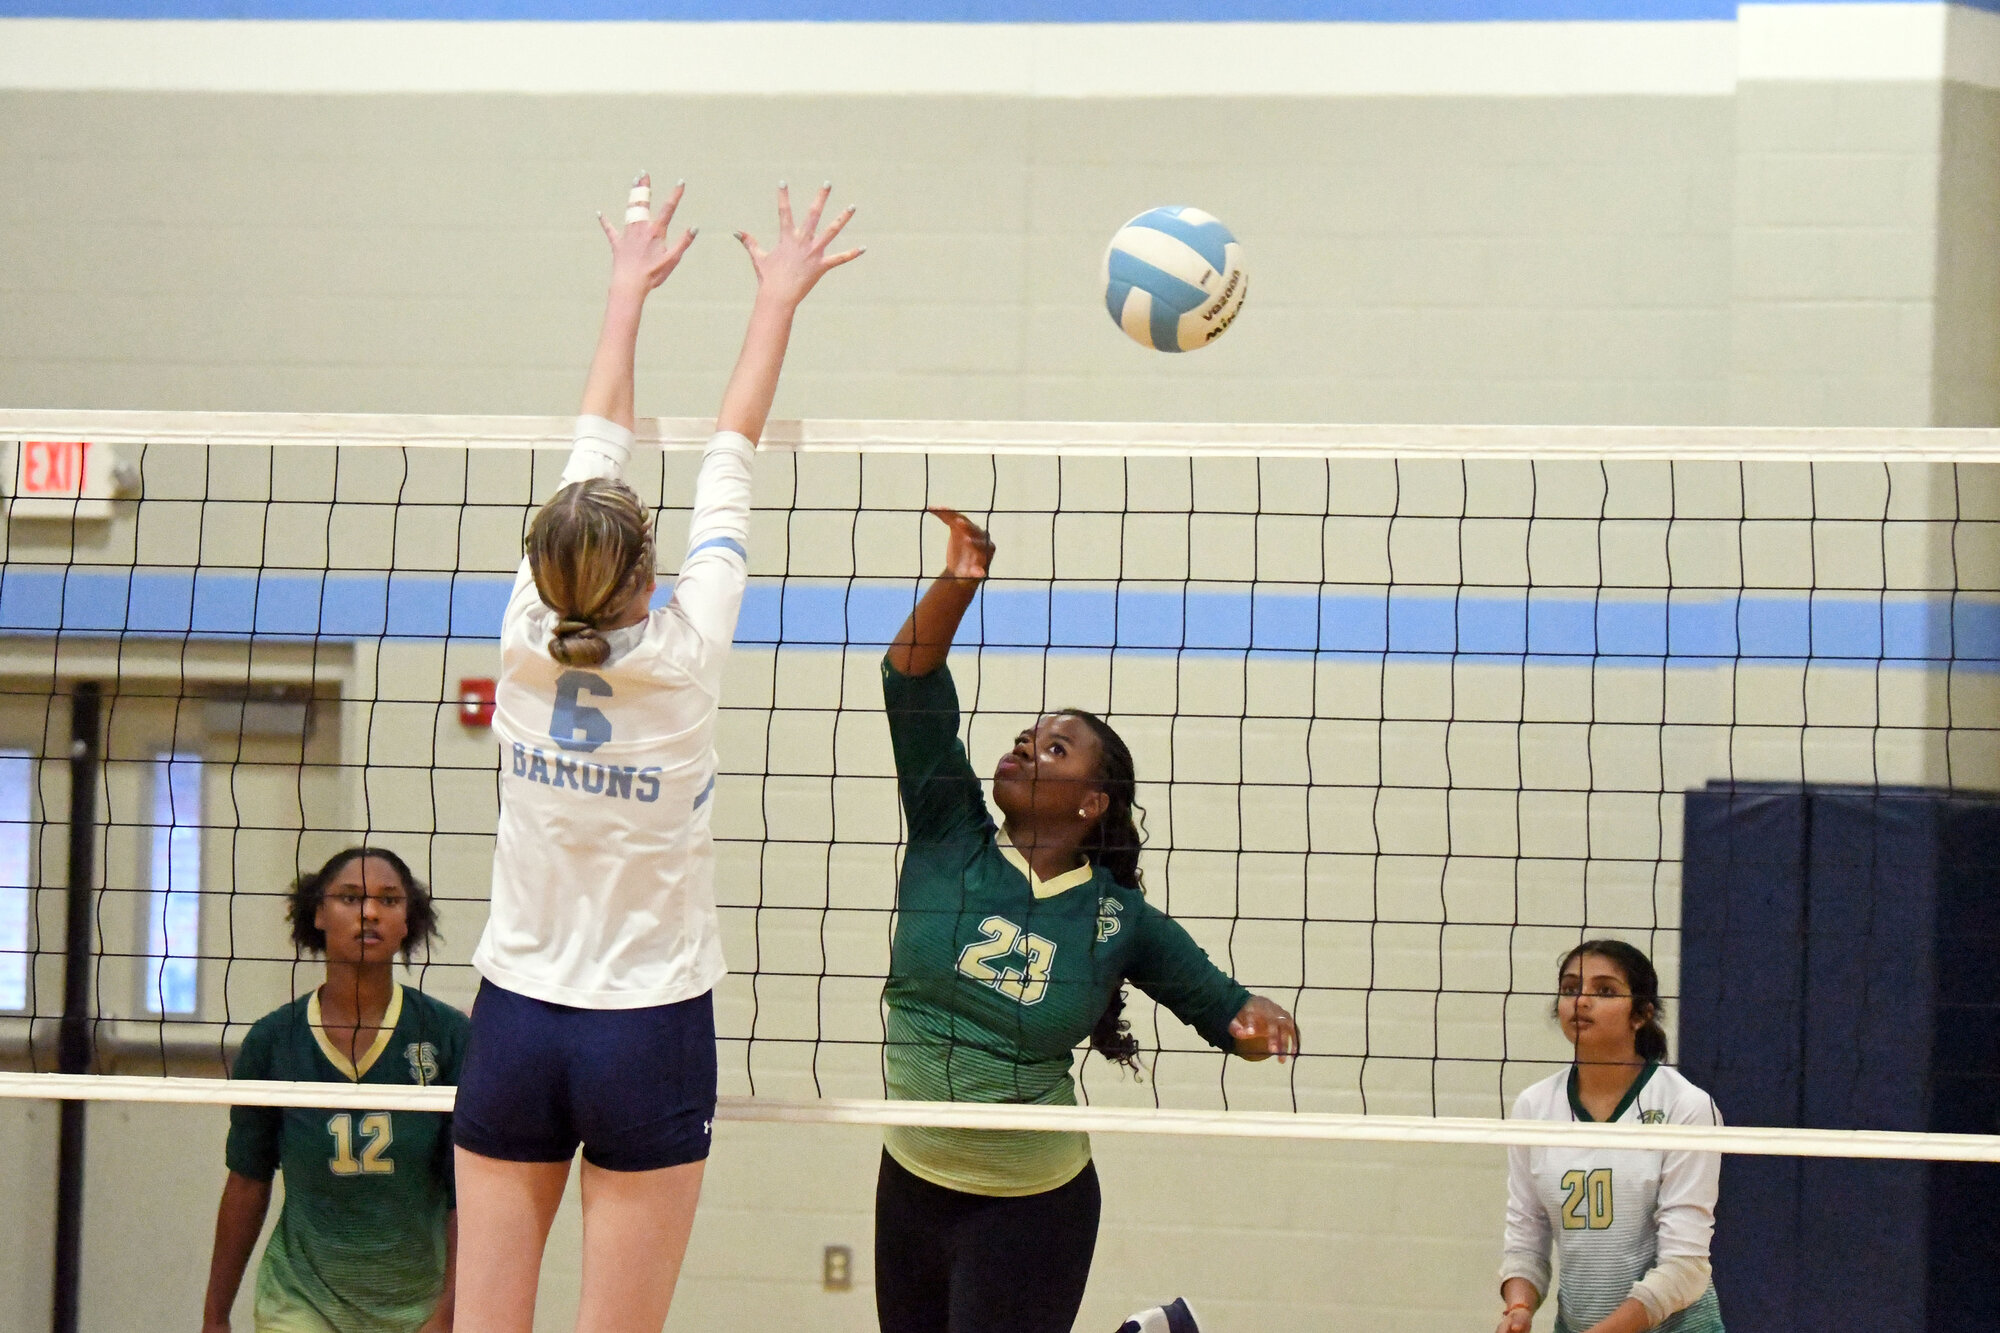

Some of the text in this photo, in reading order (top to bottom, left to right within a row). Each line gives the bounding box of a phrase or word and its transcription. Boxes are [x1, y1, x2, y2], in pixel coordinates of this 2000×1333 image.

[24, 441, 93, 492] EXIT
[549, 669, 613, 753] 6
[511, 741, 663, 803] BARONS
[955, 915, 1058, 1006] 23
[326, 1111, 395, 1176] 12
[1560, 1167, 1613, 1230] 20
